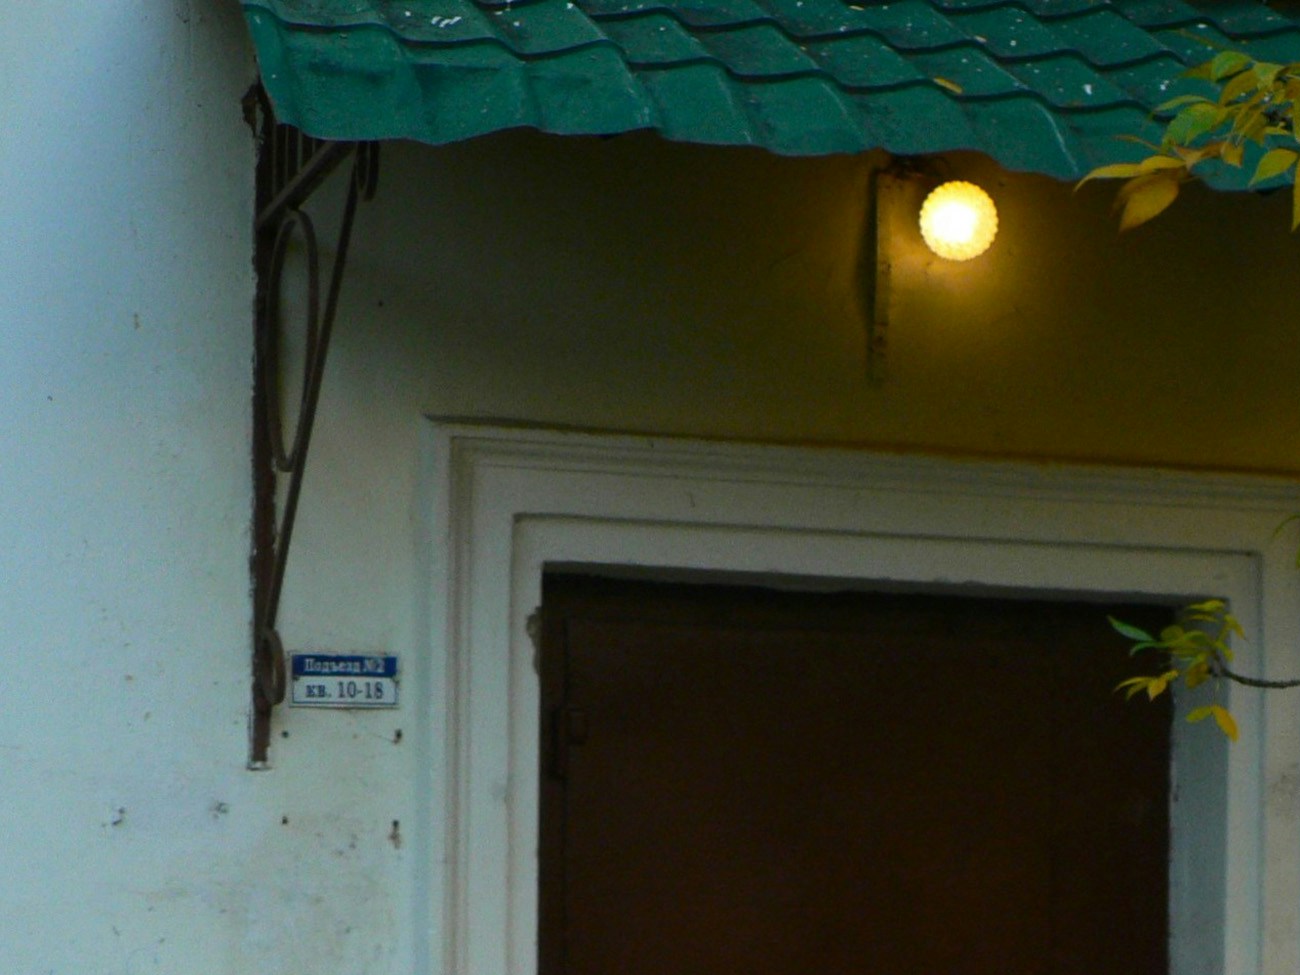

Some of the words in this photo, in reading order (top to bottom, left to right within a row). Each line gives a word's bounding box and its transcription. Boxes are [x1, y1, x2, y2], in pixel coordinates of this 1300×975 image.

[305, 658, 360, 672] Подъезд
[306, 685, 331, 698] кв.
[338, 681, 383, 699] 10-18
